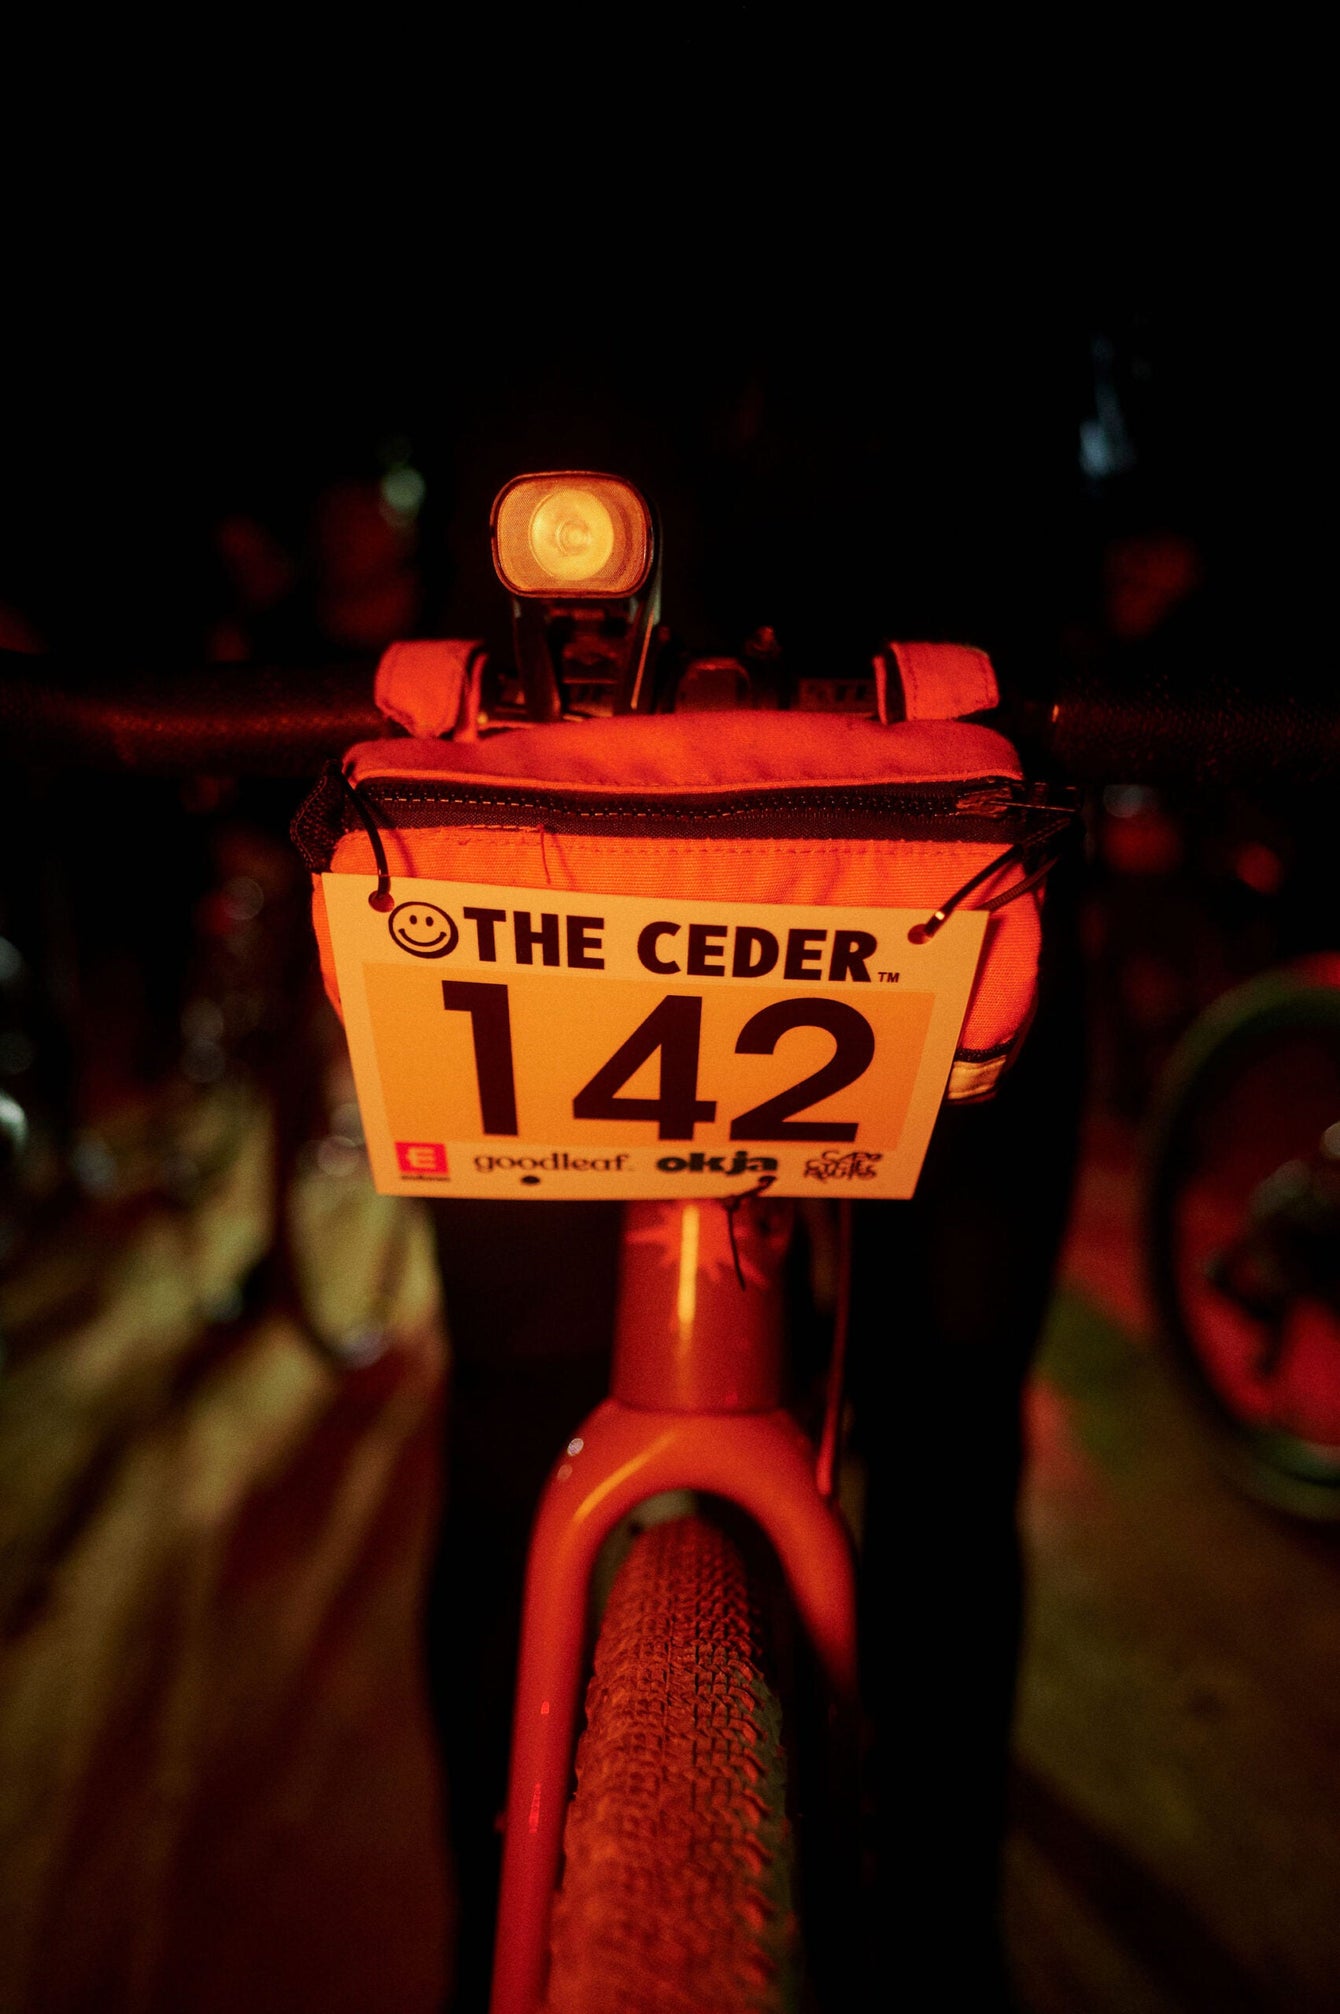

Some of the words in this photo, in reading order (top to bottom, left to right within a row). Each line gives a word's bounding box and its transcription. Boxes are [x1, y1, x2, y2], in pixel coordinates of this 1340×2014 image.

[463, 907, 605, 970] THE
[637, 921, 878, 983] CEDER
[878, 971, 900, 983] TM
[442, 980, 875, 1142] 142
[474, 1152, 629, 1173] goodleaf
[656, 1150, 779, 1175] okja
